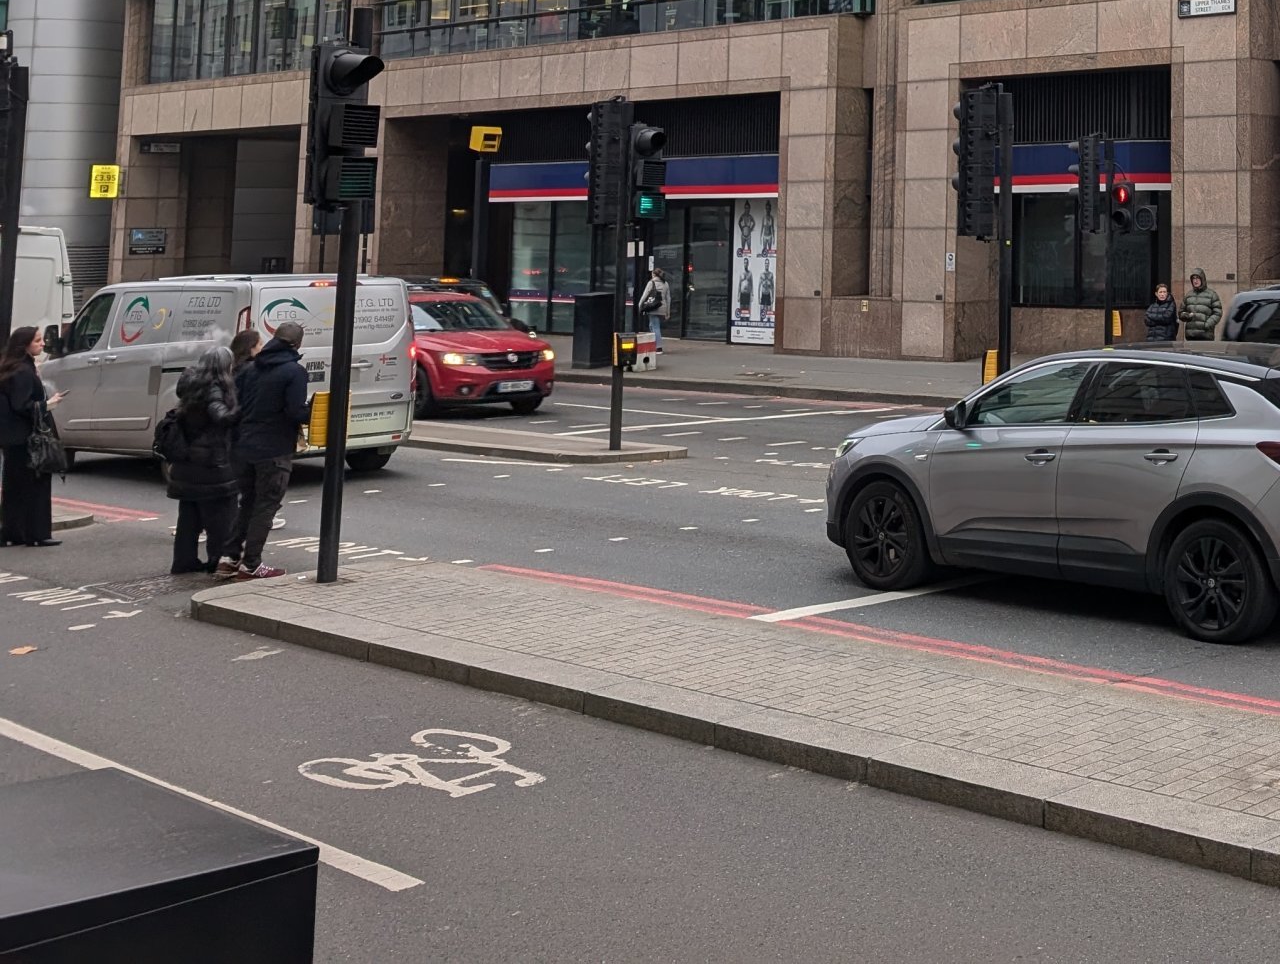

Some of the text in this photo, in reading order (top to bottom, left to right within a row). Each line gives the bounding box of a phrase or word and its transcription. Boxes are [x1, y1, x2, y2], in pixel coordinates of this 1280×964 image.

[378, 298, 394, 307] LTD
[130, 310, 143, 321] FTG
[276, 310, 297, 319] FTG
[582, 474, 798, 501] LOOK LEFT
